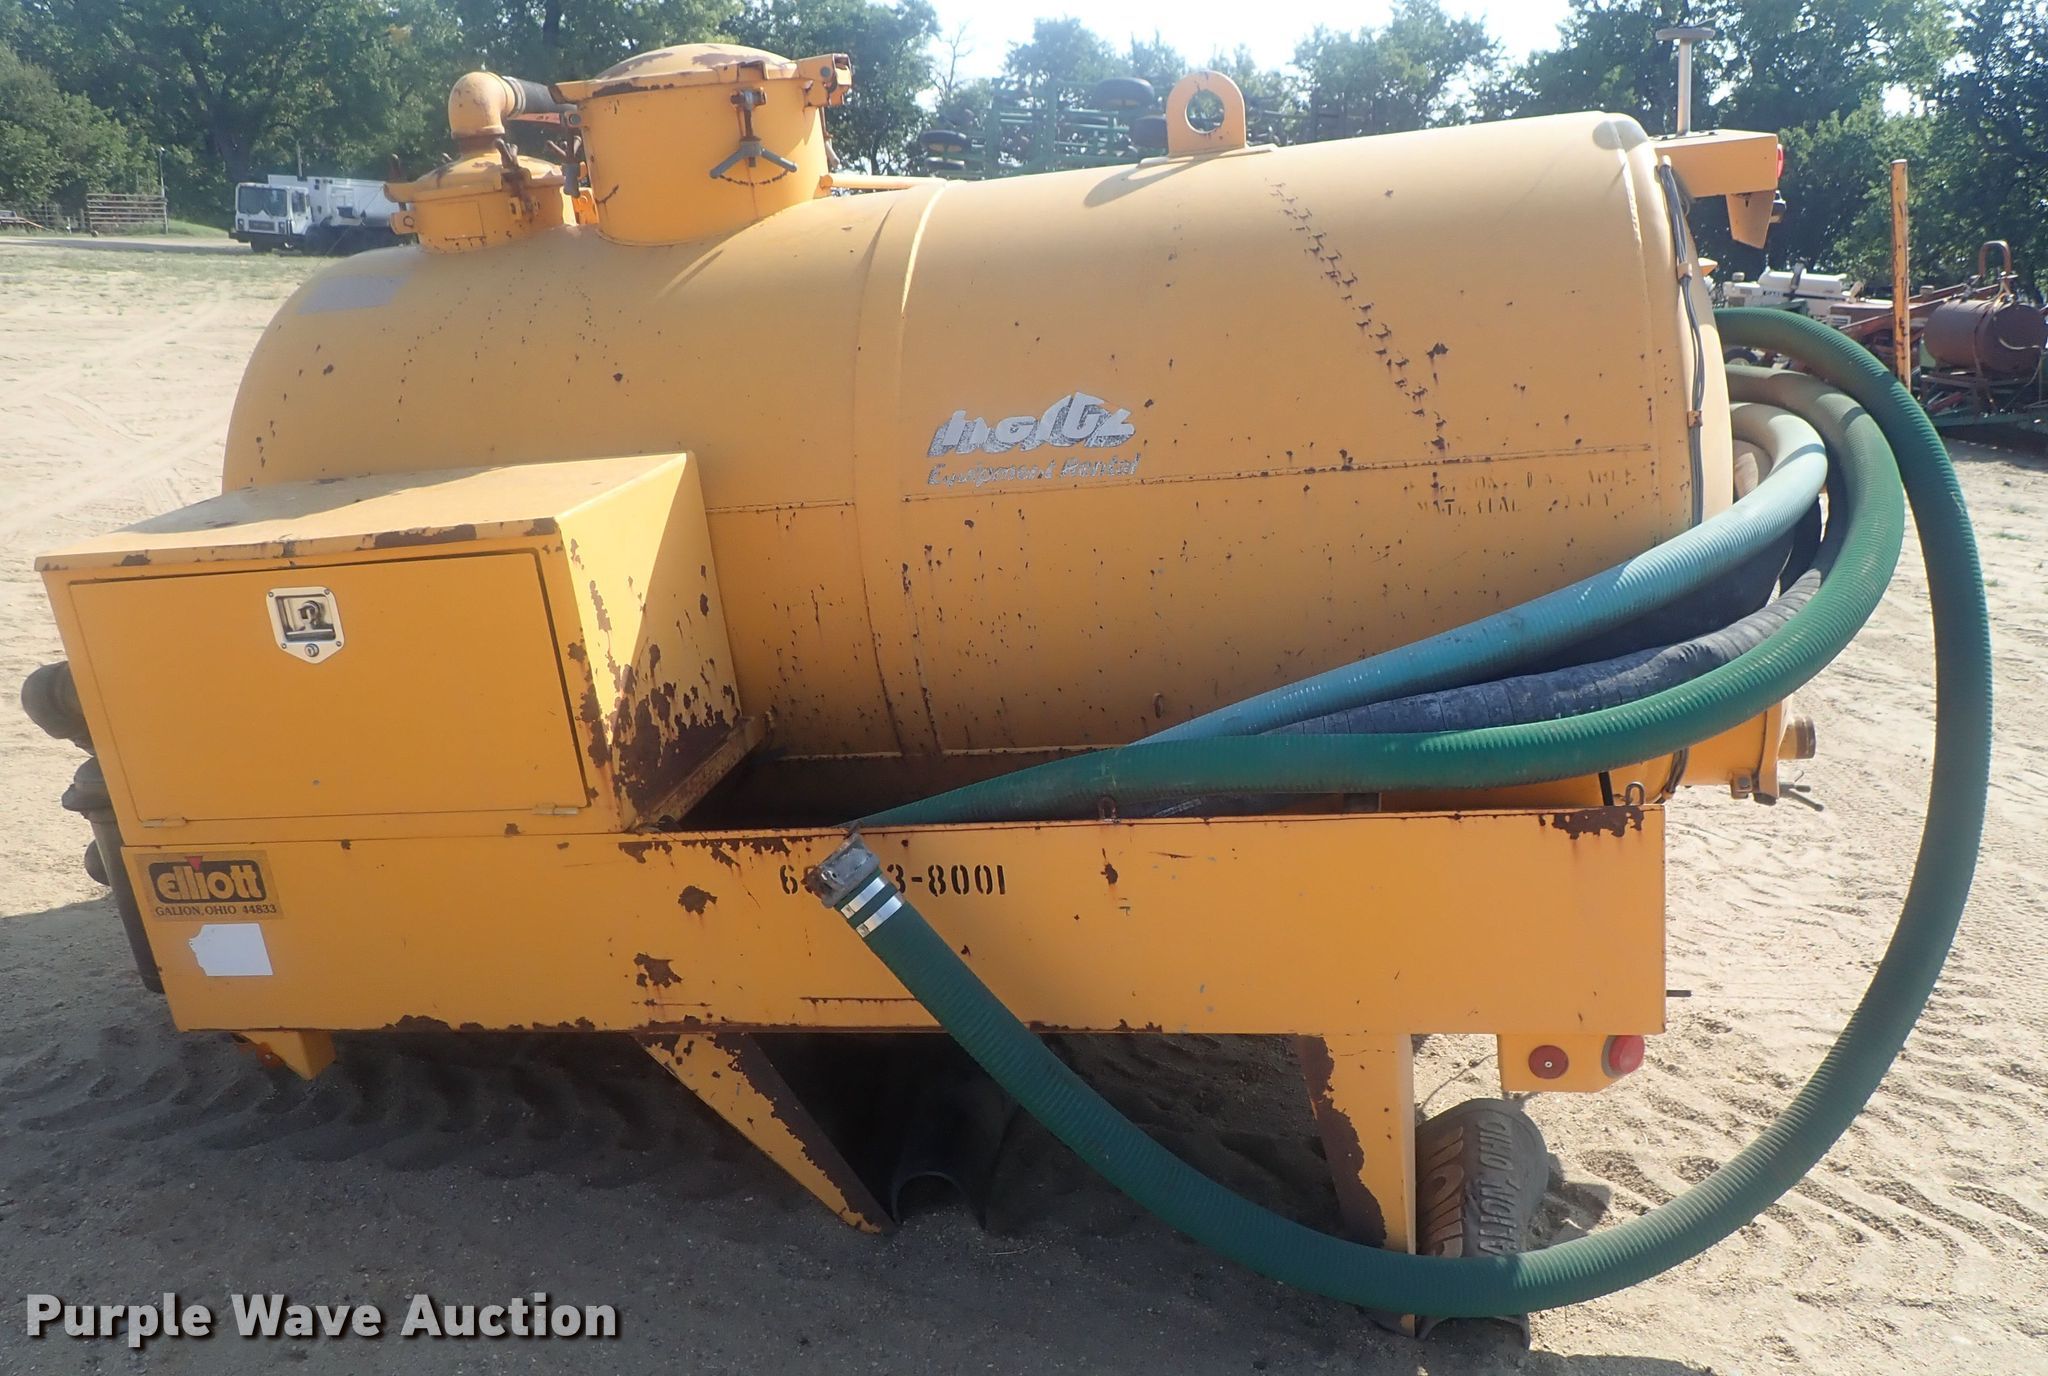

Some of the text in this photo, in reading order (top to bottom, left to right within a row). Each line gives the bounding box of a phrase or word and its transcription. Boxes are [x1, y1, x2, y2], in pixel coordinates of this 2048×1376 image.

[155, 904, 277, 916] GALION, OHIO 44833
[1476, 1116, 1521, 1257] ALION, OHIO
